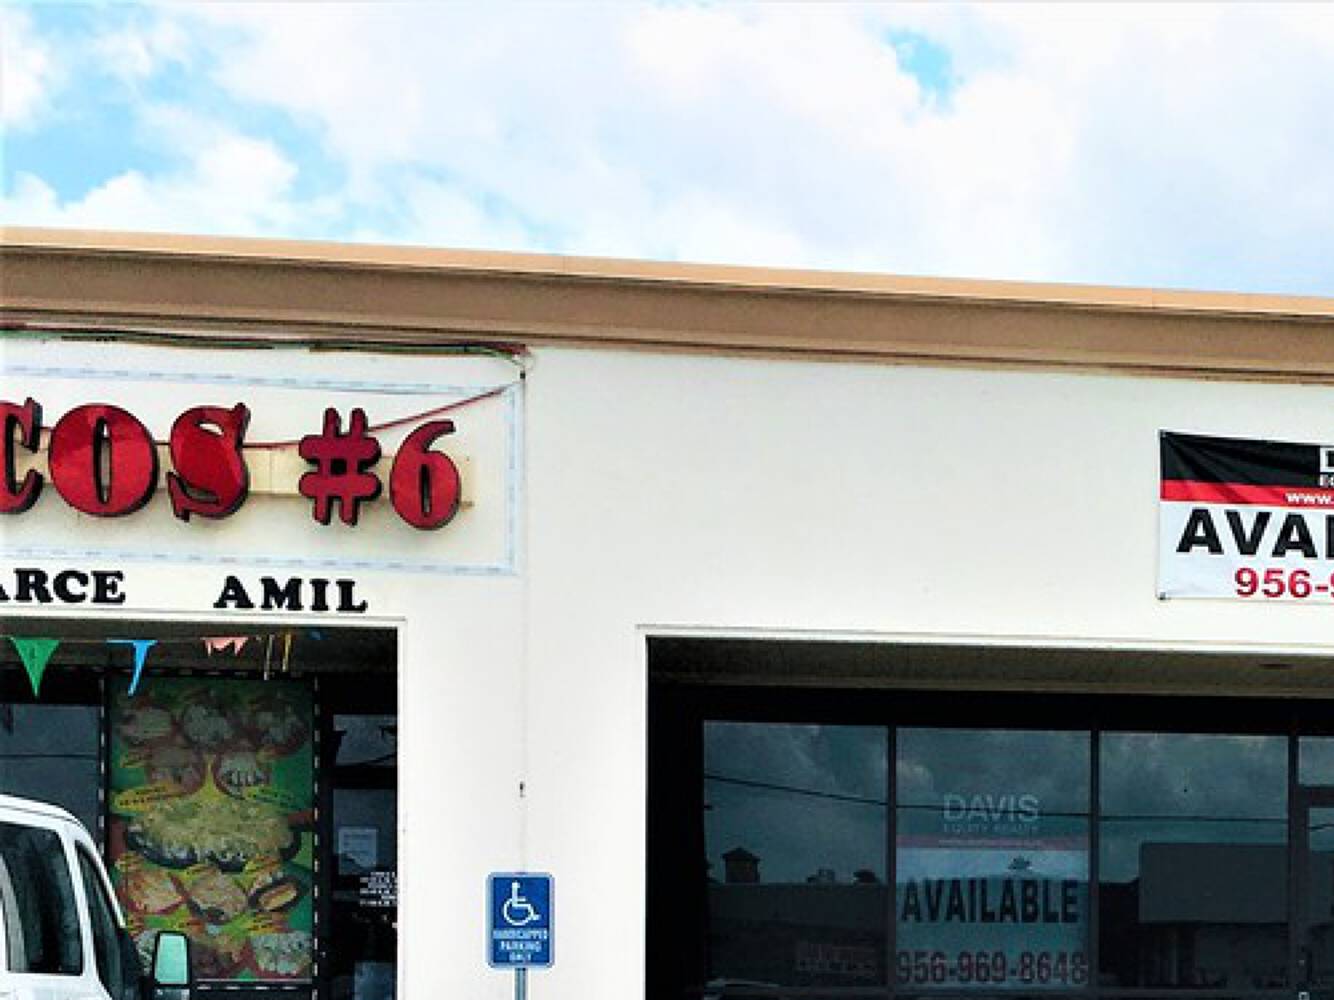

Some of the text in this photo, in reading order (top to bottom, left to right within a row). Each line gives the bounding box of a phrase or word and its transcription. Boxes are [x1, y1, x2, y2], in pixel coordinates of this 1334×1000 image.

[299, 407, 463, 530] #6
[0, 569, 366, 612] RCE AMIL
[943, 794, 1039, 822] DAVIS
[902, 877, 1078, 923] AVAILABLE
[896, 952, 1088, 984] 956-969-8648
